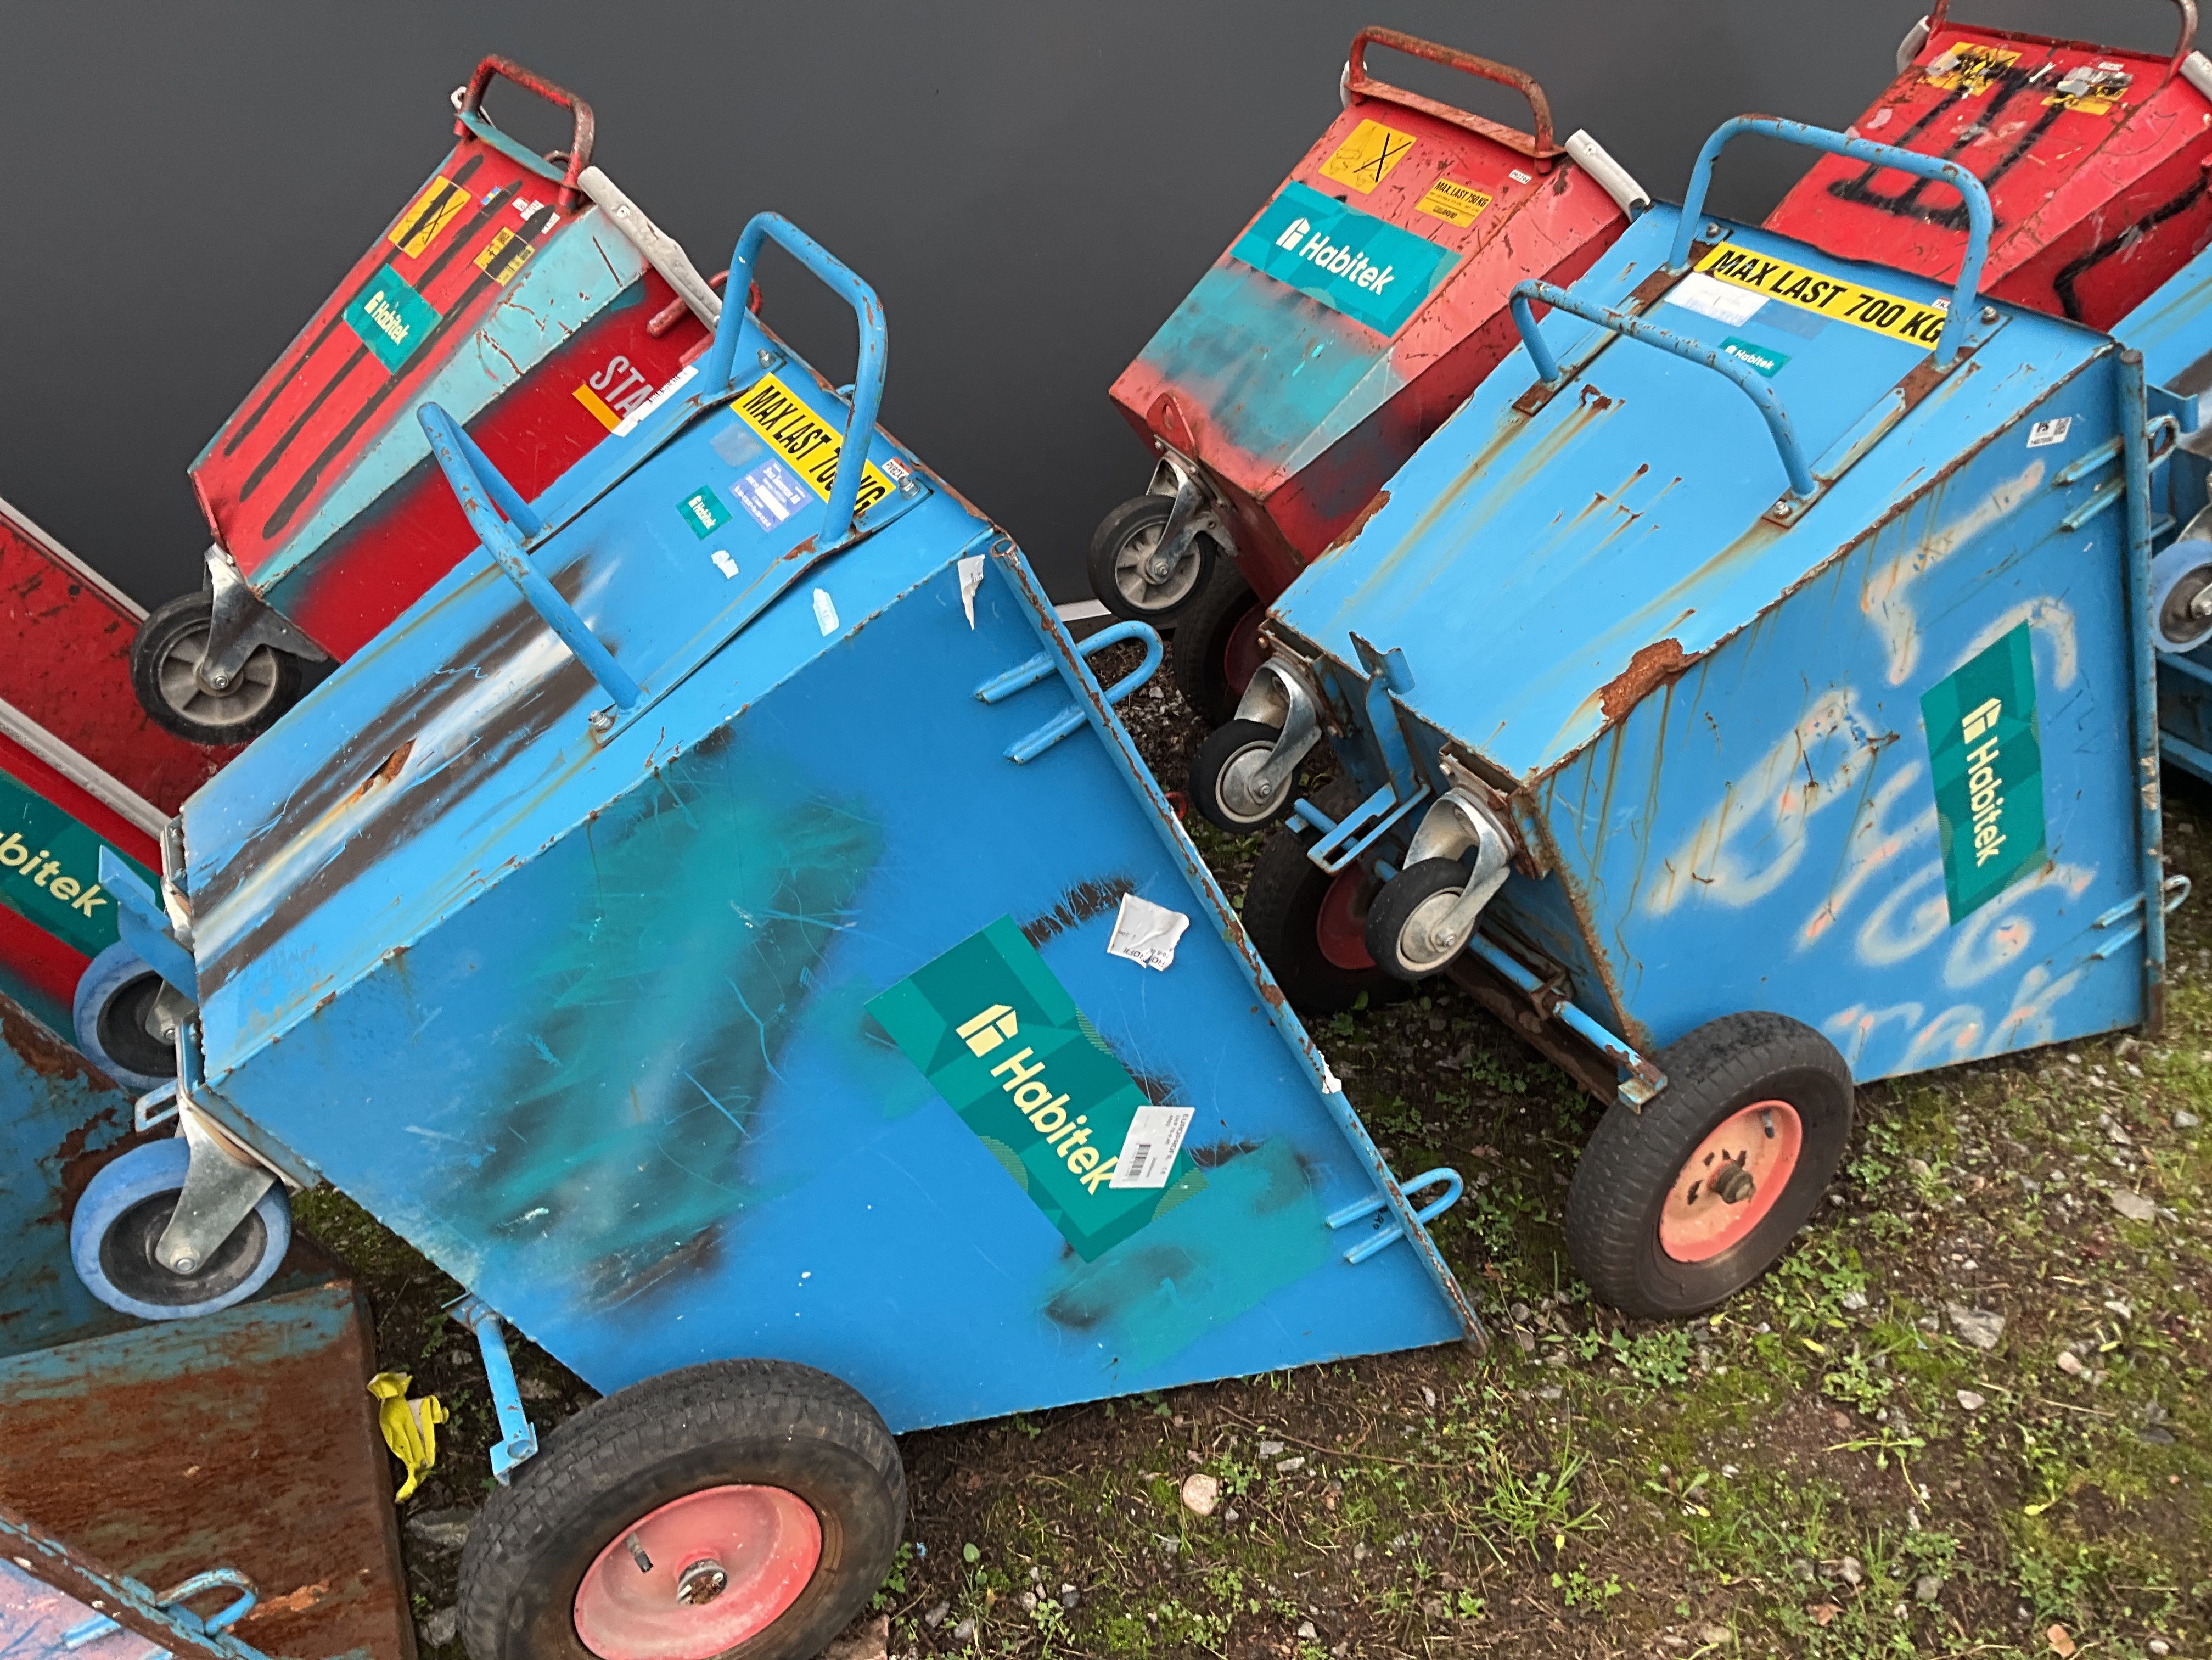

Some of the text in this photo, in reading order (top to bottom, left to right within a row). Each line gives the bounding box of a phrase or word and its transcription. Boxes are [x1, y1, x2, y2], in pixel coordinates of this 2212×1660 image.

[1450, 187, 1468, 200] LAST
[1465, 192, 1480, 204] 750
[1476, 197, 1489, 207] KG
[1299, 231, 1395, 296] Habitek
[1715, 250, 1946, 343] MAX LAST 700 KG
[372, 300, 410, 345] Habitek
[1734, 349, 1775, 369] Habitek
[743, 385, 799, 431] MAX
[772, 414, 832, 461] LAST
[809, 447, 841, 491] 70
[693, 502, 717, 530] Habitek
[1965, 735, 2008, 867] Habitek
[0, 832, 108, 918] bitek
[991, 1046, 1118, 1195] Habitek
